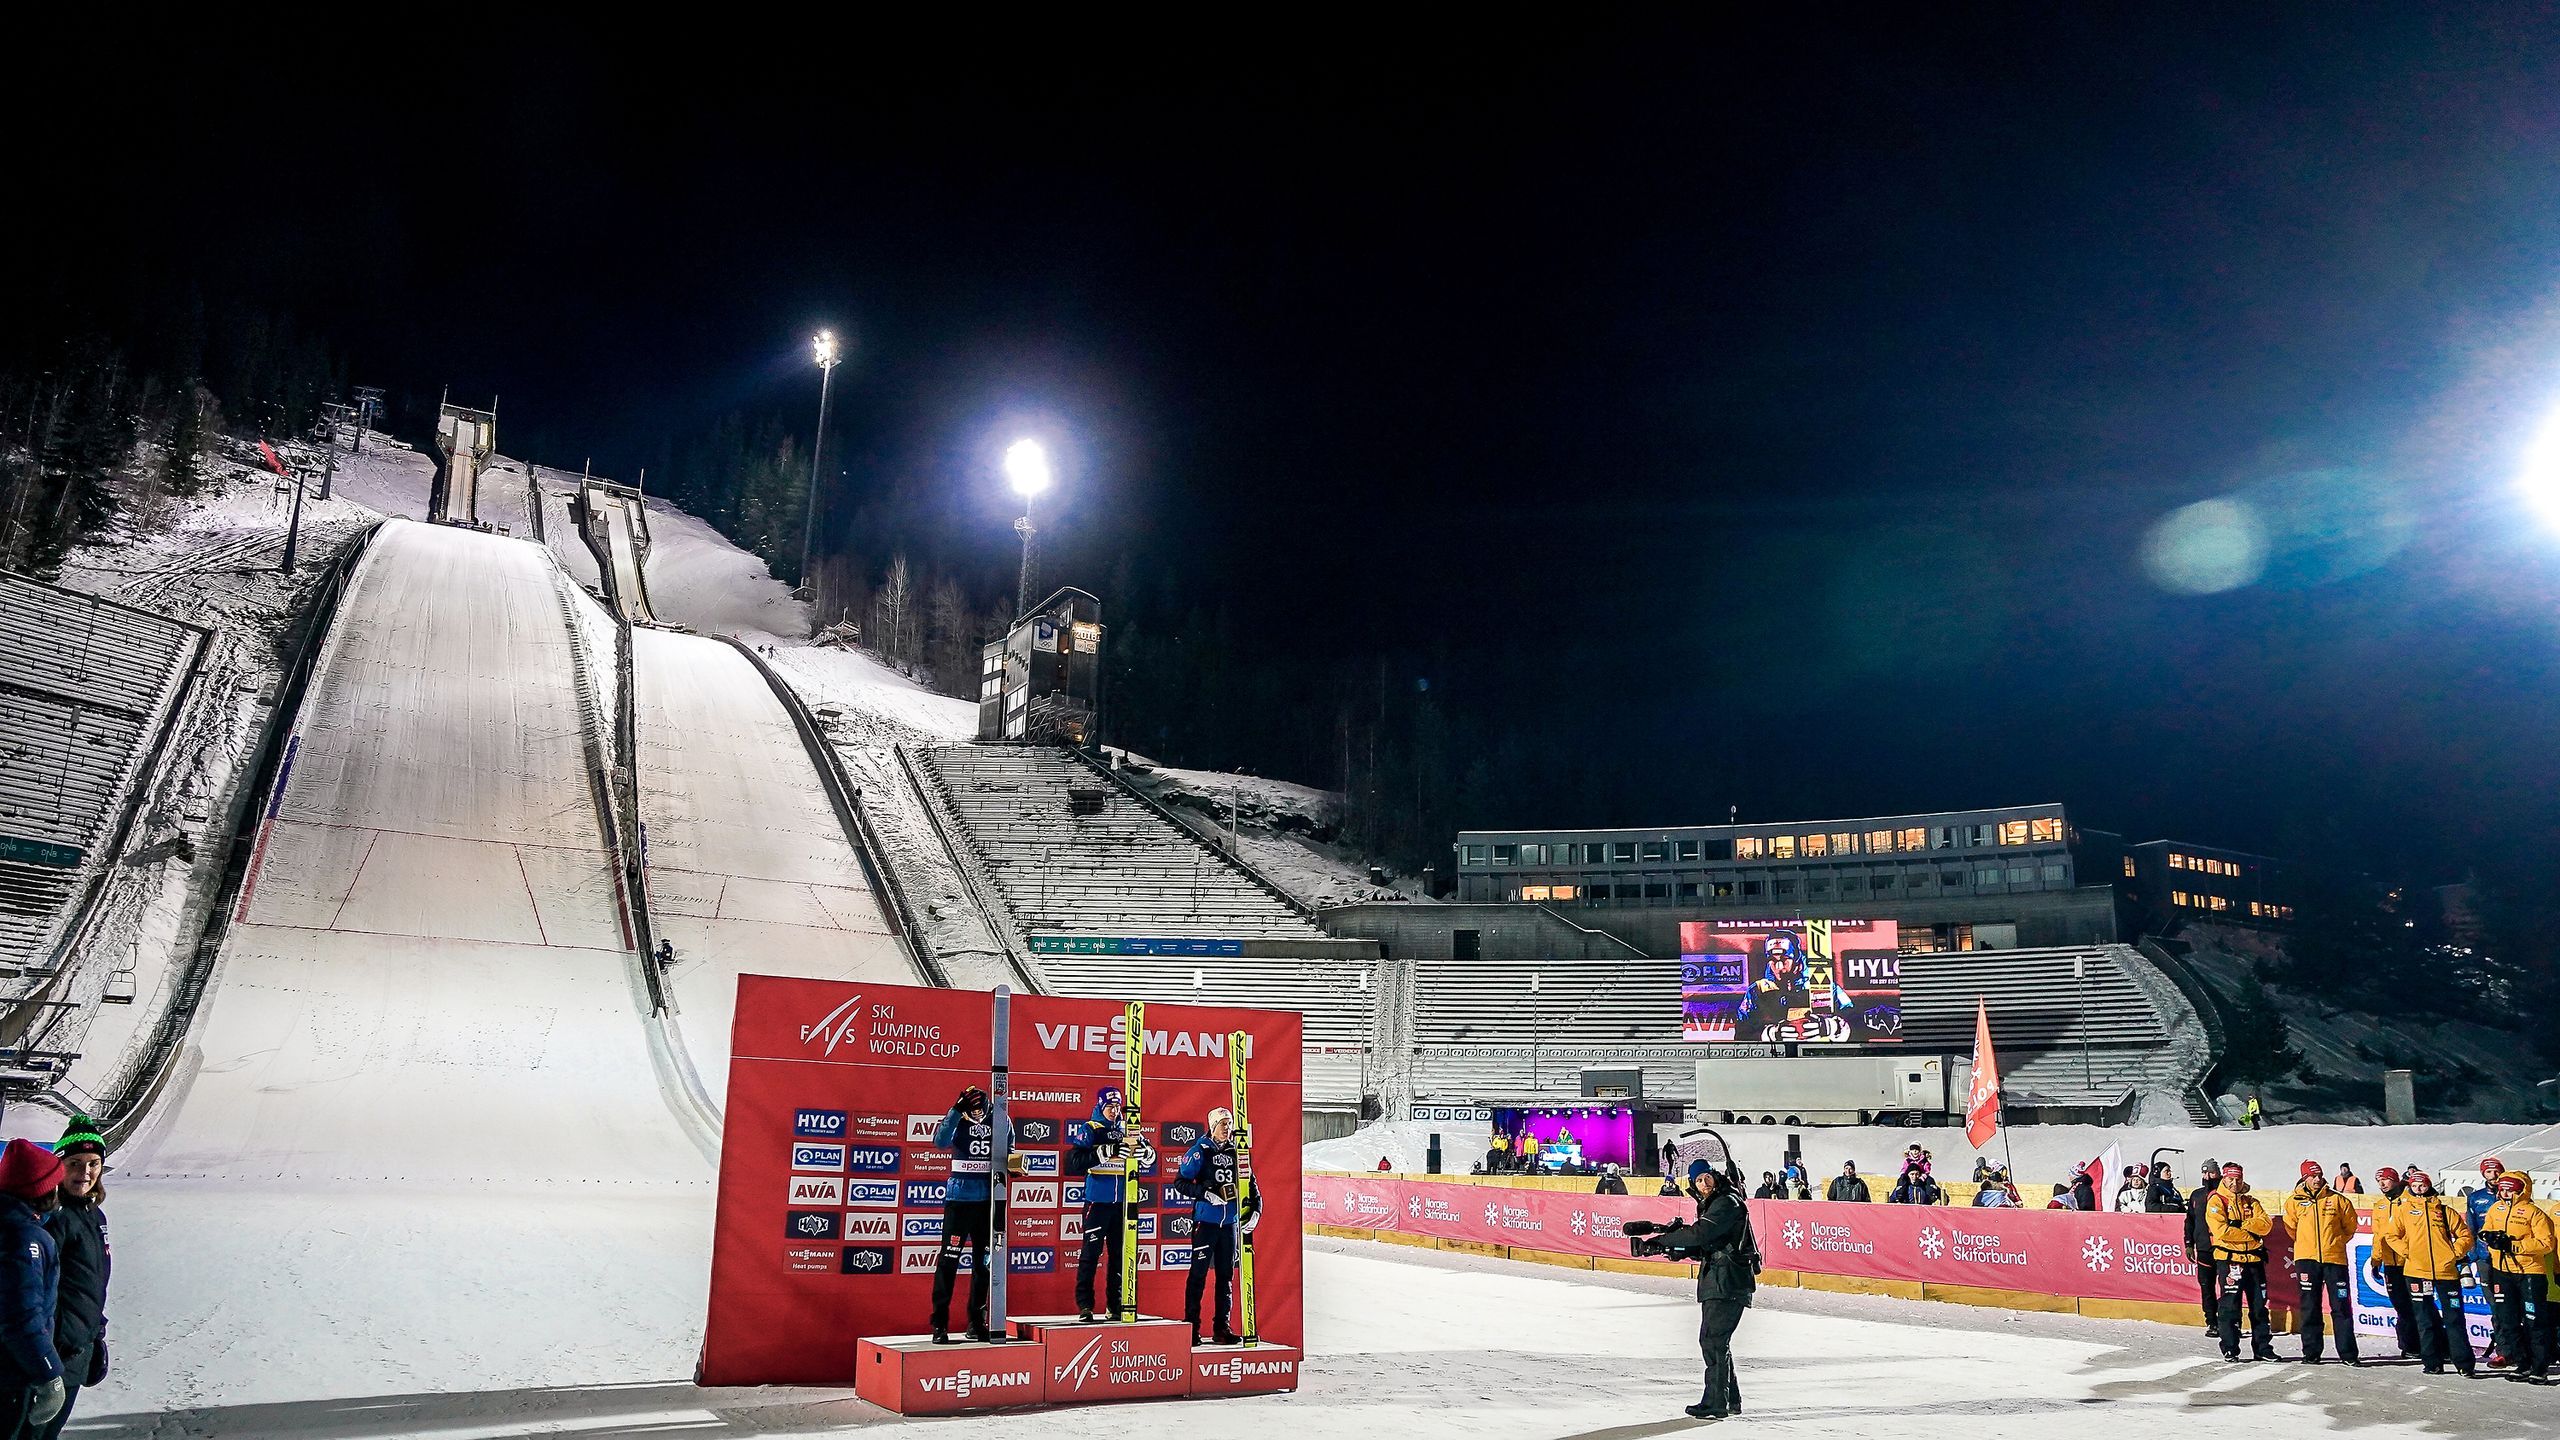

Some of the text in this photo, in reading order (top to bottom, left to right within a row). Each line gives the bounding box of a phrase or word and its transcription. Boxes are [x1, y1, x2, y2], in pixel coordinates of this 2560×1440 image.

[871, 1004, 895, 1019] SKI
[870, 1022, 940, 1040] JUMPING
[869, 1040, 960, 1058] WORLD CUP
[1129, 1003, 1142, 1107] FISCHER
[1236, 1033, 1246, 1130] FISCHER
[969, 1140, 990, 1155] 65
[814, 1152, 840, 1161] PLAN
[1032, 1157, 1055, 1166] PLAN
[1215, 1169, 1233, 1183] 63
[869, 1187, 895, 1196] PLAN
[1424, 1197, 1449, 1210] Norges
[1502, 1204, 1529, 1219] Norges
[1591, 1212, 1621, 1226] Norges
[1501, 1216, 1542, 1231] Skiforbund
[1810, 1222, 1851, 1238] Norges
[1810, 1237, 1874, 1254] Skiforbund
[1952, 1230, 2000, 1250] Norges
[1952, 1247, 2027, 1265] Skiforbund
[2123, 1238, 2182, 1260] Norges
[2358, 1313, 2384, 1326] Gibt
[1110, 1340, 1129, 1353] SKI
[1110, 1354, 1167, 1368] JUMPING
[1109, 1368, 1183, 1384] WORLD CUP
[1198, 1357, 1292, 1384] VIESSMANN
[919, 1369, 1030, 1398] VIESSMANN
